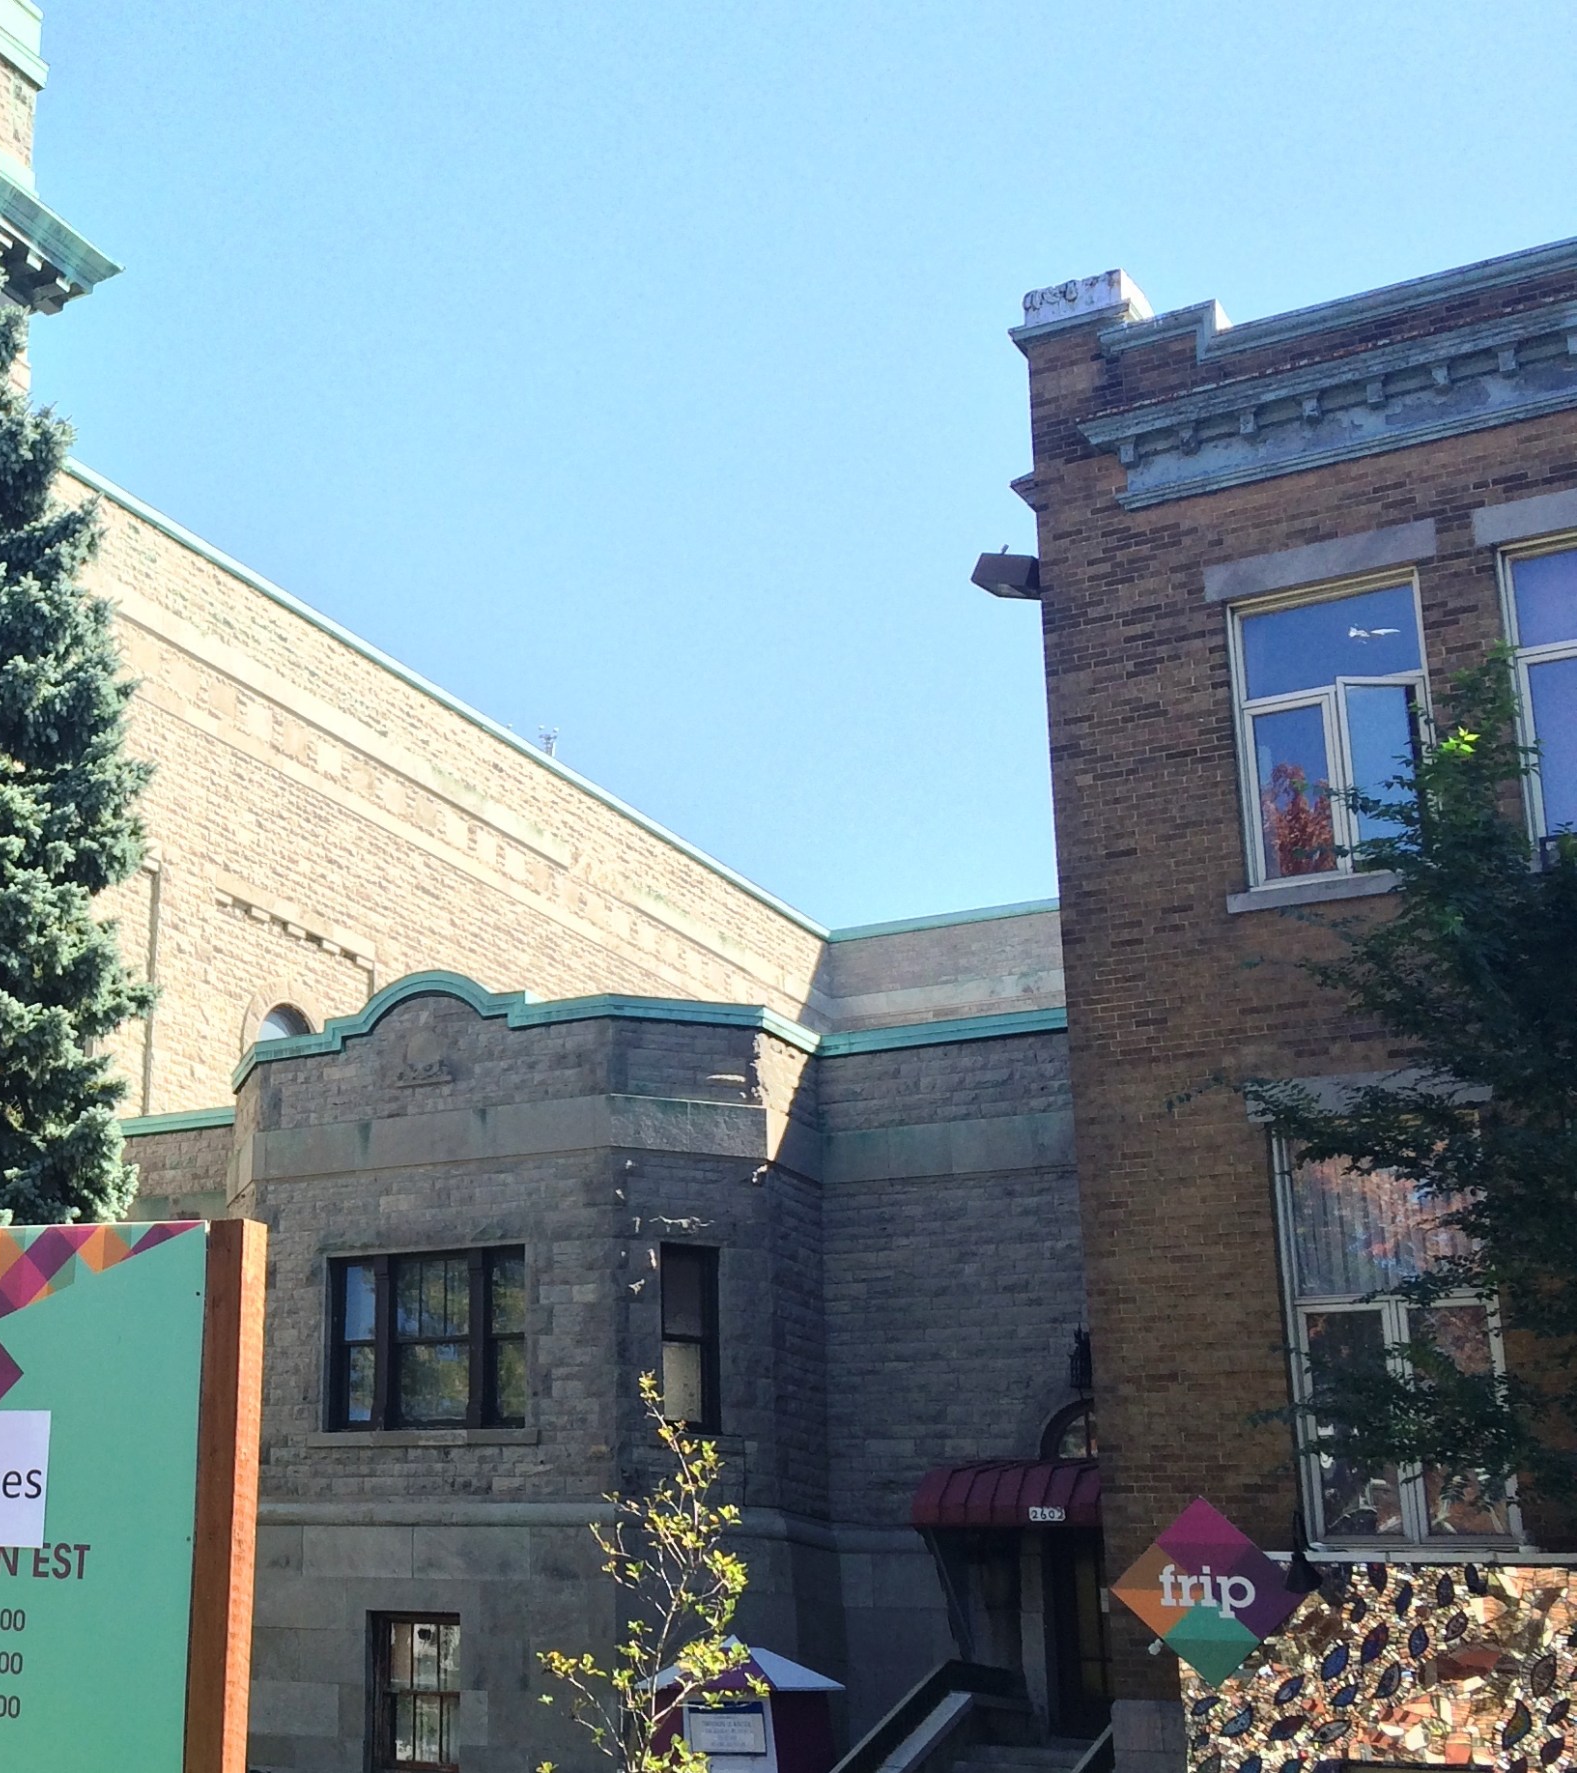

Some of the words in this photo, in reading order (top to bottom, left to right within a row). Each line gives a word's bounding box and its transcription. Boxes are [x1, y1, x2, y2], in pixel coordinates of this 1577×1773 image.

[1031, 1508, 1064, 1520] 2602
[32, 1543, 91, 1580] EST
[1159, 1564, 1256, 1619] frip
